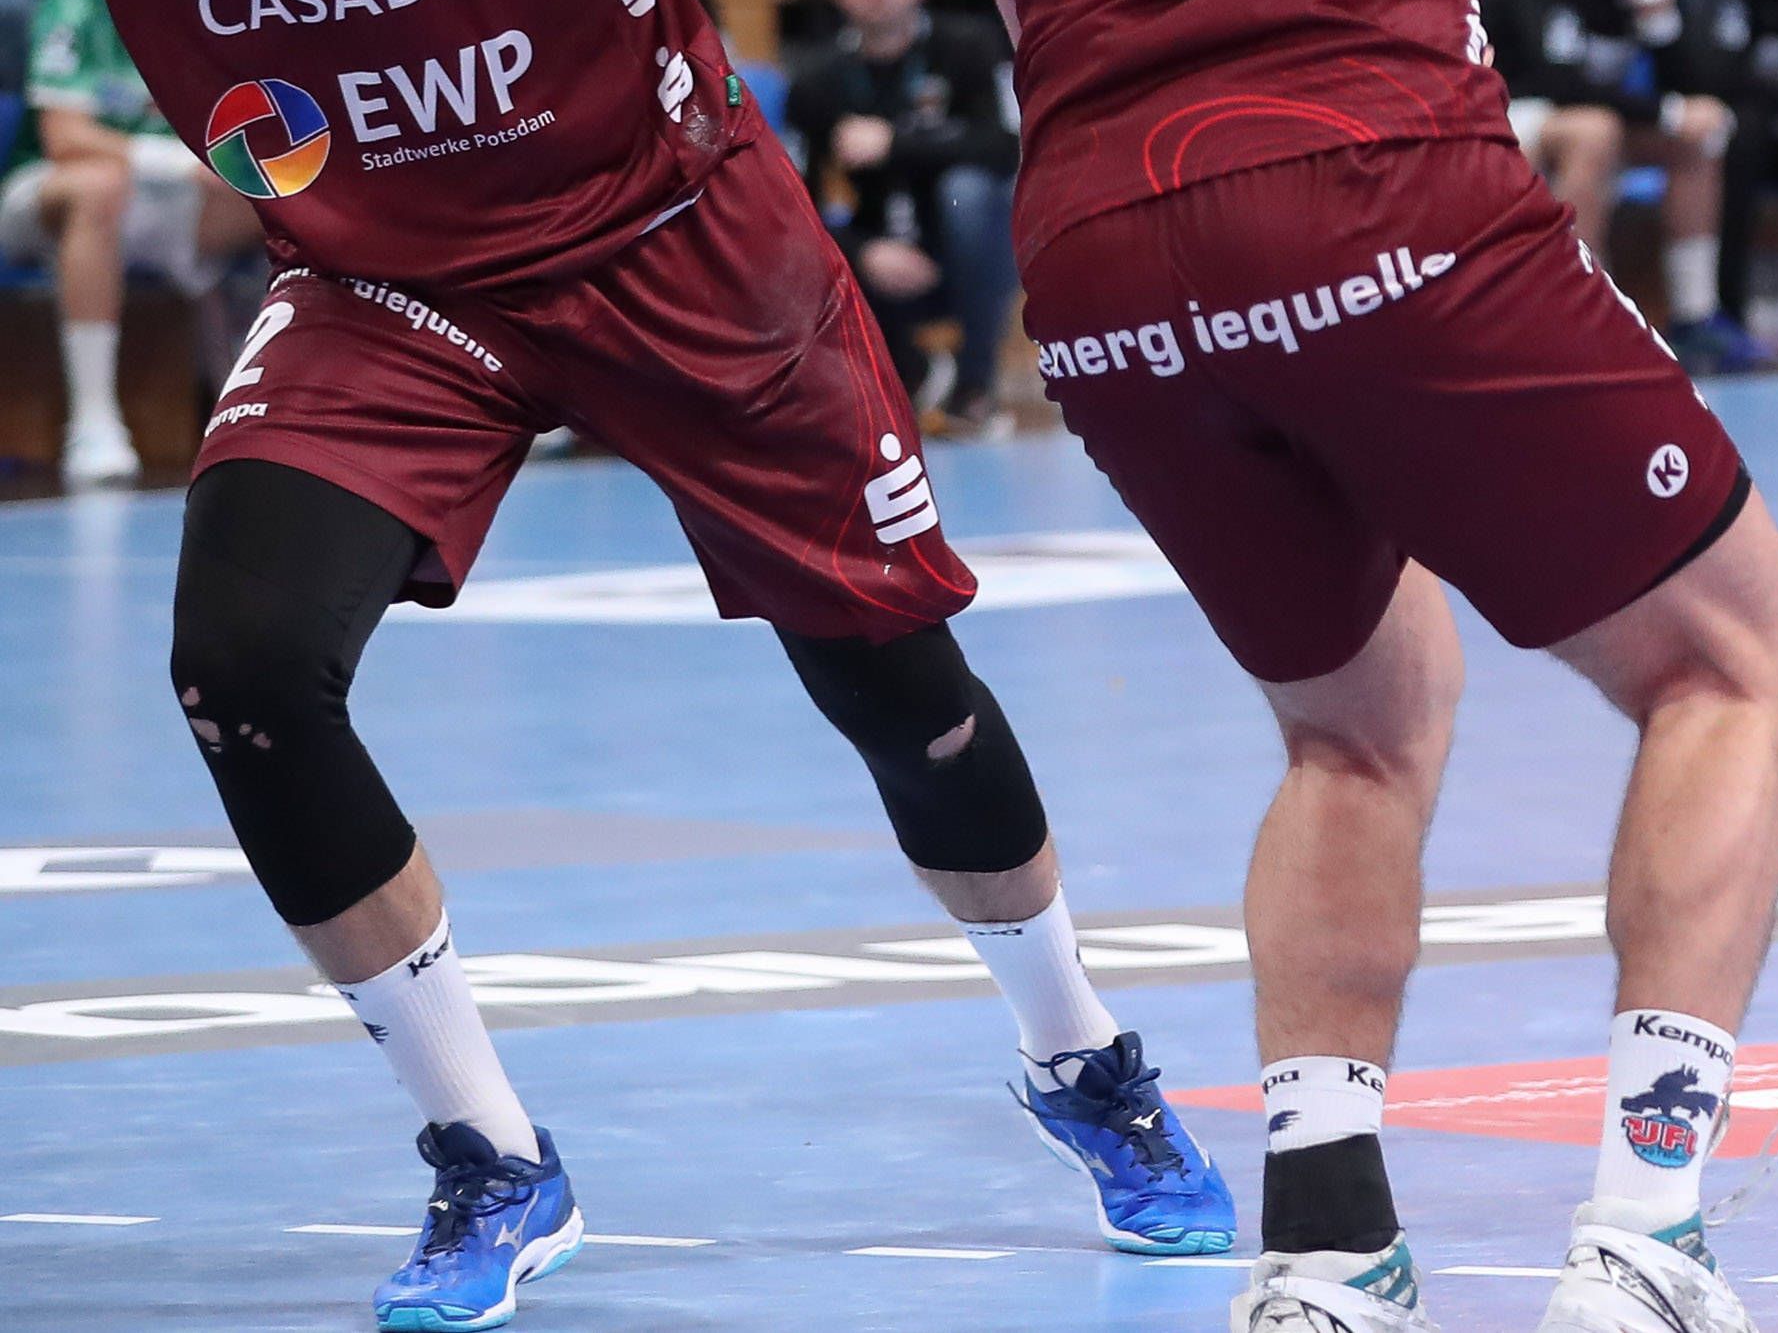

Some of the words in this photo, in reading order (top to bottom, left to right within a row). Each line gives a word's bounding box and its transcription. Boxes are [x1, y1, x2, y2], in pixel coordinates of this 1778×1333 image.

[337, 29, 534, 143] EWP
[361, 137, 472, 171] Stadtwerke
[475, 109, 556, 149] Potsdam
[217, 301, 296, 402] 2
